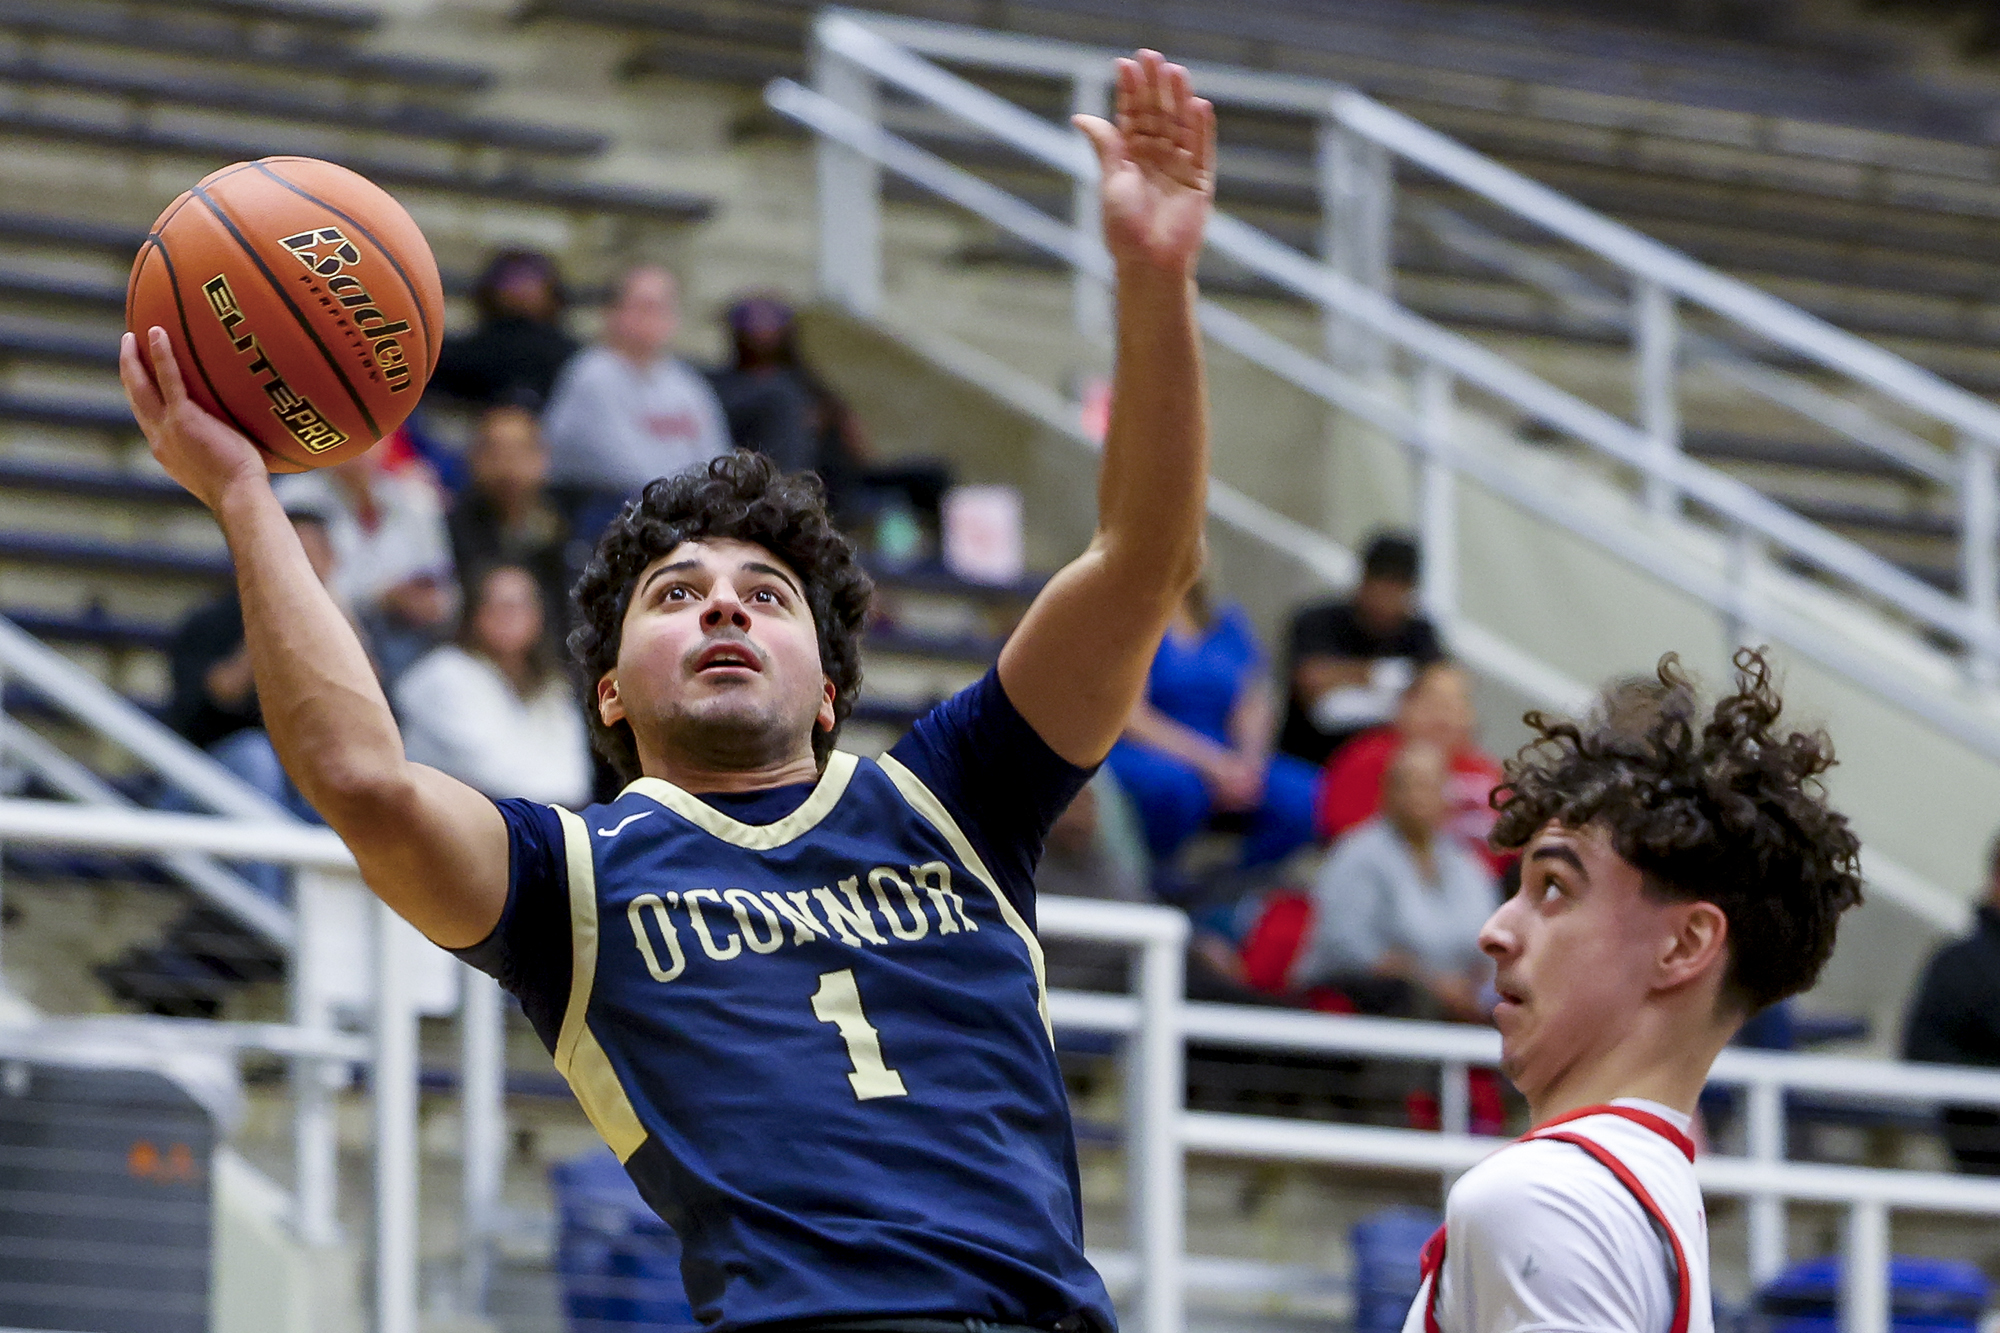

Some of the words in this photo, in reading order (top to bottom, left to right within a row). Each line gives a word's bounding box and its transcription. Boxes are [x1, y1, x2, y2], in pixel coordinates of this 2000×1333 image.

[277, 226, 412, 395] Baden
[299, 275, 379, 383] PERFECTION
[282, 406, 343, 452] PRO
[627, 860, 980, 983] O'CONNOR
[810, 968, 909, 1101] 1
